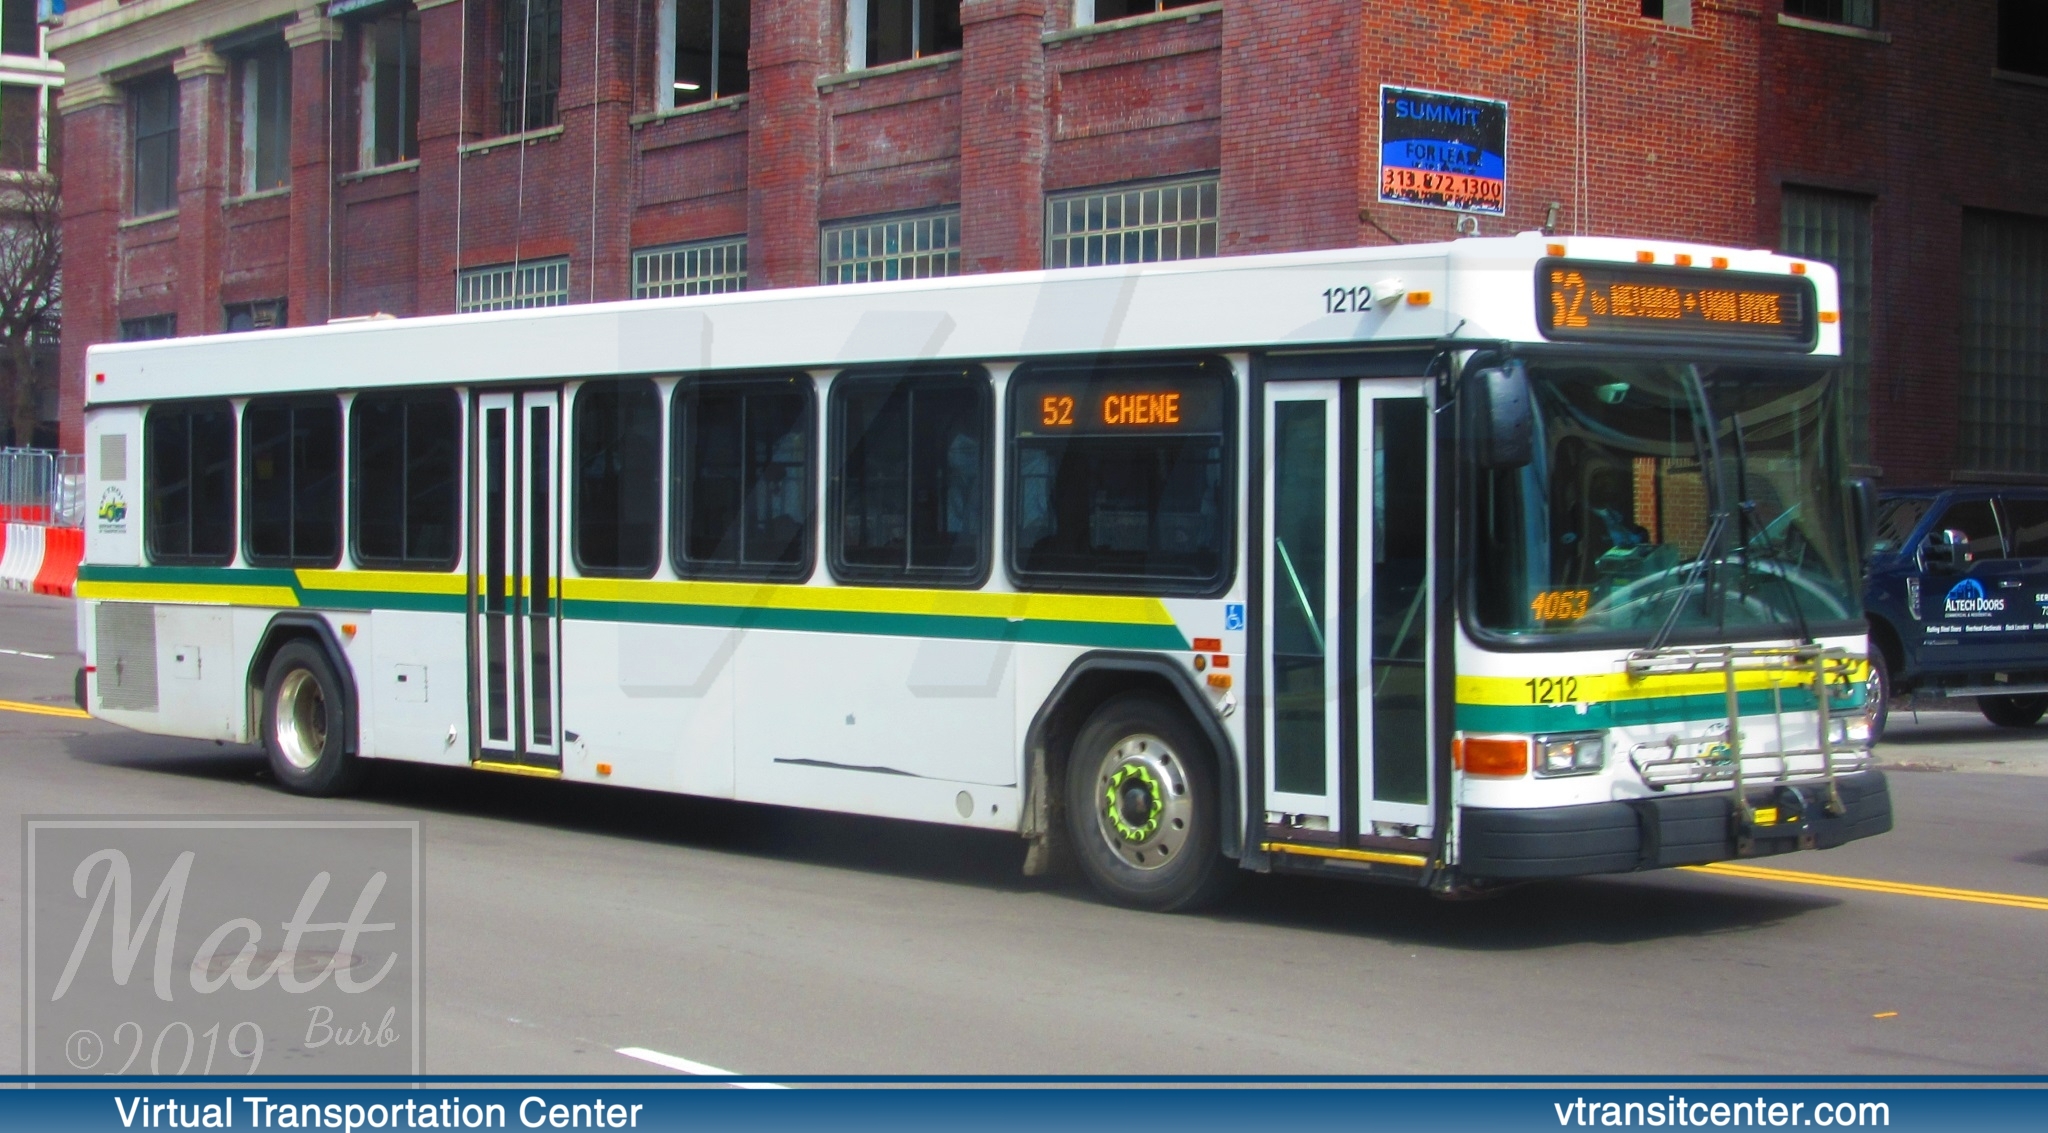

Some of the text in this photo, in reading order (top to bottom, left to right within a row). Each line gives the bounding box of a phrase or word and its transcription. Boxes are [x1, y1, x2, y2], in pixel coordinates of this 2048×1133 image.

[1396, 100, 1480, 126] SUMMIT
[1405, 143, 1483, 167] FOR LEA
[1385, 168, 1501, 198] 313.872.1300
[1322, 286, 1372, 313] 1212
[1043, 393, 1181, 425] 52 CHENE
[1531, 590, 1589, 620] 4063
[1945, 598, 2004, 612] ALTECH DOORS
[1525, 676, 1578, 704] 1212
